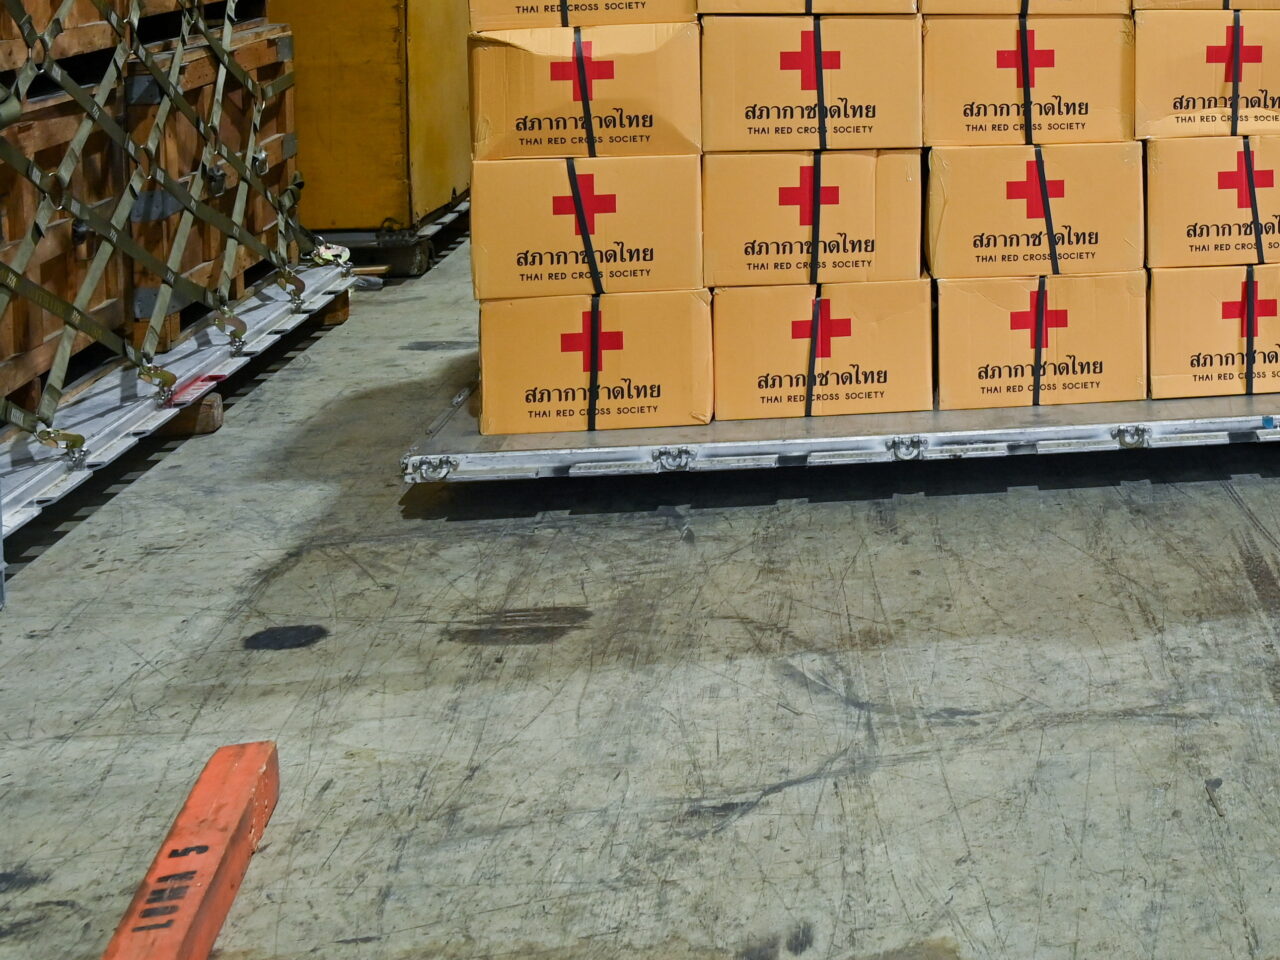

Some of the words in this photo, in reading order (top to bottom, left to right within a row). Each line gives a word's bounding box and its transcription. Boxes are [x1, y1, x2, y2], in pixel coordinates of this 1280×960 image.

[515, 5, 539, 14] THAI
[568, 3, 599, 12] CROSS
[604, 1, 646, 11] SOCIETY
[1199, 115, 1217, 123] RED
[1221, 114, 1249, 123] CRSS
[747, 126, 770, 135] THAI
[774, 126, 793, 135] RED
[833, 125, 874, 134] SOCIETY
[965, 124, 987, 132] THAI
[991, 123, 1009, 132] RED
[1014, 123, 1043, 131] CRSS
[1047, 122, 1086, 131] SOCIETY
[519, 137, 543, 146] THAI
[547, 136, 567, 145] RED
[609, 134, 652, 144] SOCIETY
[1189, 244, 1210, 252] THAI
[1213, 243, 1231, 251] RED
[1236, 242, 1260, 251] CROS
[975, 255, 997, 263] THAI
[1001, 254, 1019, 262] RED
[1057, 251, 1096, 260] SOCIETY
[746, 262, 769, 271] THAI
[773, 261, 792, 270] RED
[832, 259, 872, 269] SOCIETY
[519, 273, 543, 282] THAI
[547, 272, 567, 281] RED
[572, 270, 604, 280] CROS
[609, 268, 652, 278] SOCIETY
[1192, 374, 1213, 382] THAI
[1217, 372, 1235, 381] RED
[1239, 371, 1267, 380] COSS
[980, 386, 1002, 394] THAI
[1006, 384, 1024, 393] RED
[1029, 383, 1058, 392] COSS
[1062, 381, 1102, 390] SOCIETY
[759, 395, 783, 404] THAI
[787, 394, 806, 403] RED
[845, 390, 886, 400] SOCIETY
[527, 410, 551, 418] THAI
[555, 409, 575, 417] RED
[616, 405, 658, 415] SOCIETY
[168, 844, 209, 859] 5
